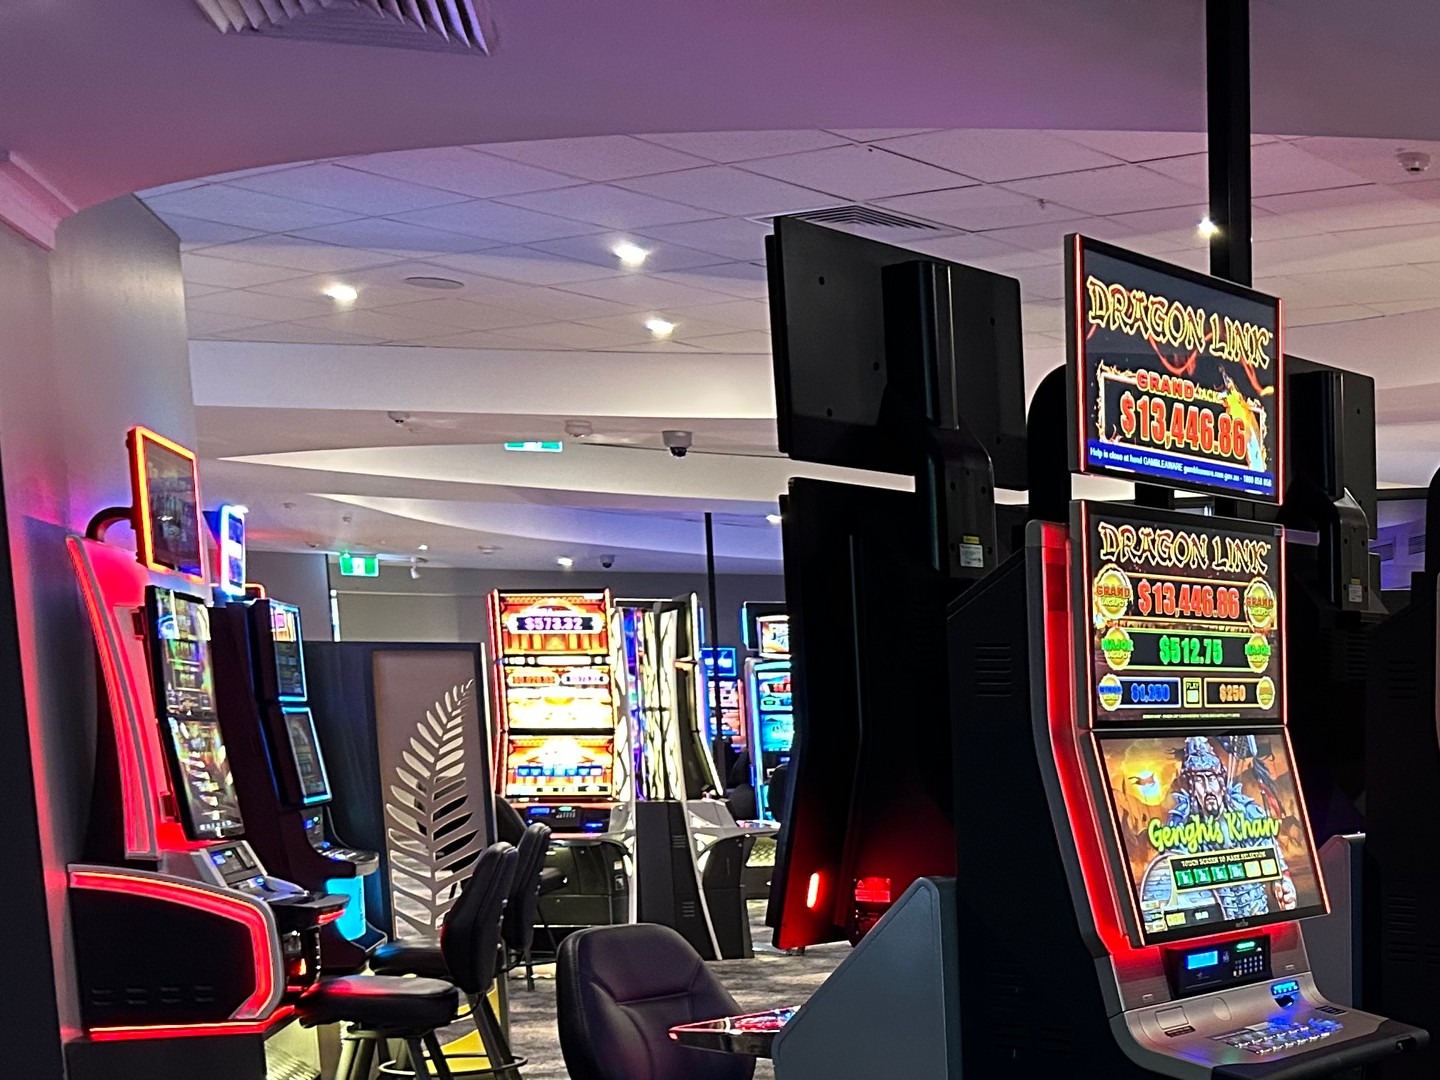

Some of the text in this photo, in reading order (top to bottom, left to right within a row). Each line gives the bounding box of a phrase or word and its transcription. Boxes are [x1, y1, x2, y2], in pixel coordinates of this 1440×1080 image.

[1087, 275, 1269, 369] DRAGON LINK
[1137, 369, 1195, 402] GRAND
[1120, 391, 1246, 460] $13,446.86
[1098, 521, 1268, 575] DRAGON LINK
[1096, 585, 1131, 599] GRAND
[1138, 578, 1240, 619] $13,446.86
[1159, 635, 1223, 665] $512.75
[1131, 683, 1170, 703] $1,250
[1219, 684, 1246, 703] $250
[1149, 811, 1279, 853] Genghis Khan
